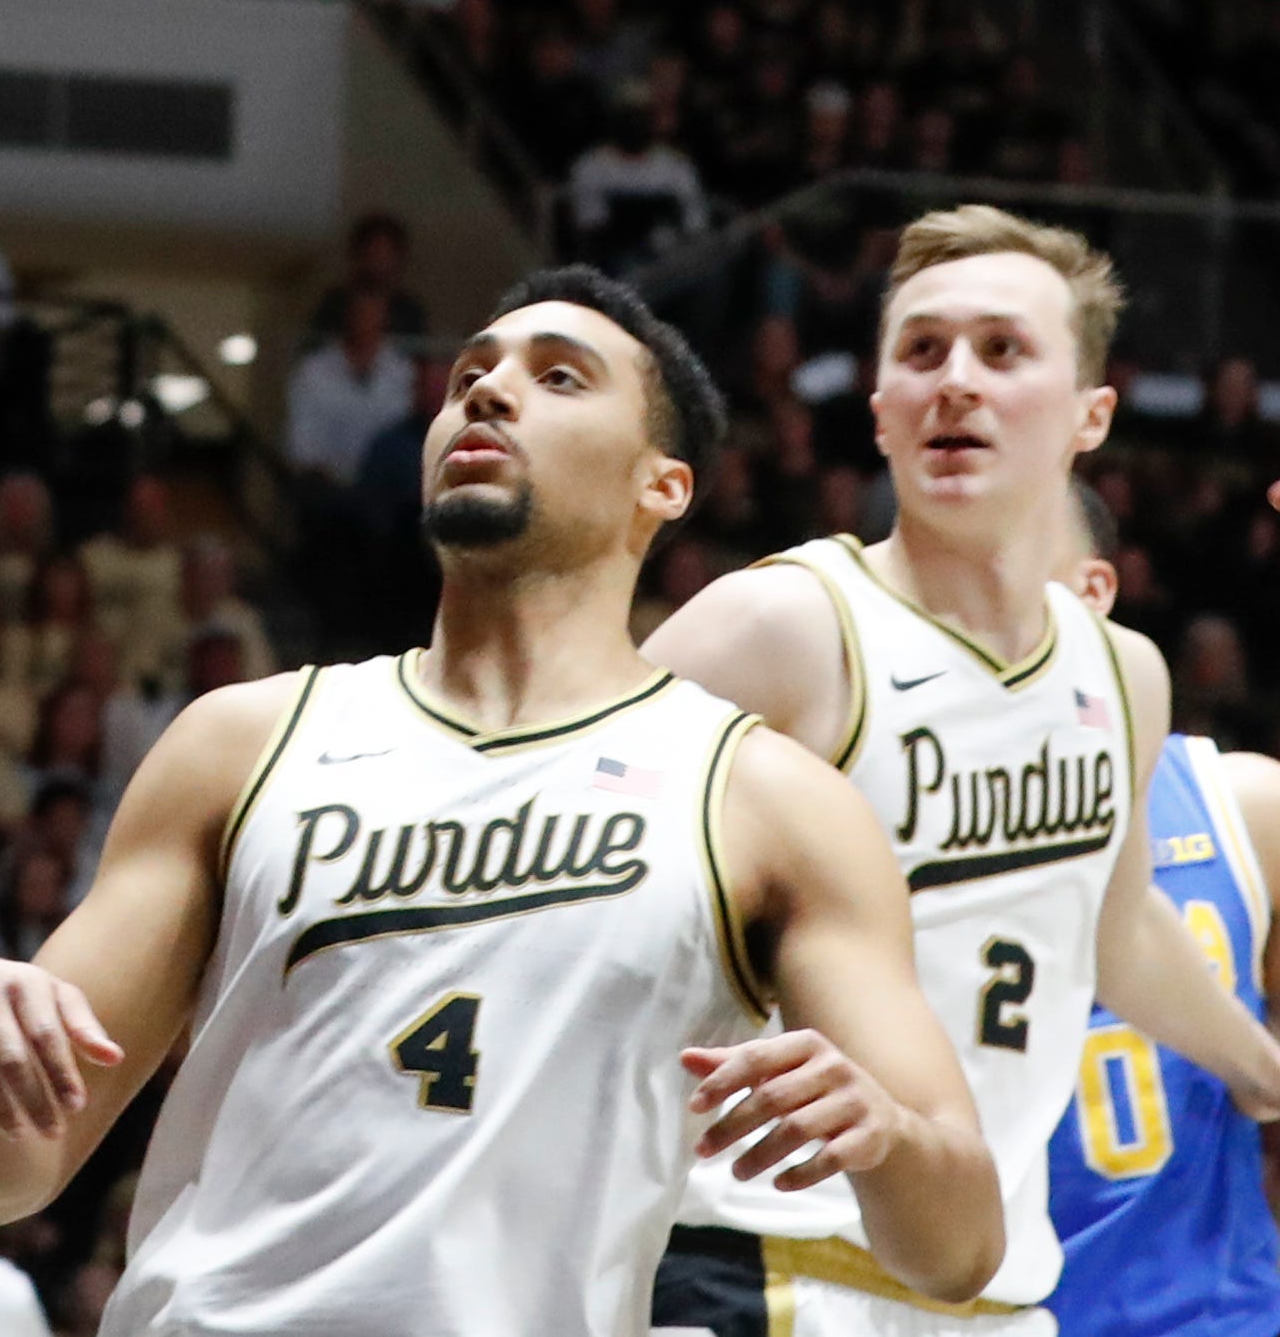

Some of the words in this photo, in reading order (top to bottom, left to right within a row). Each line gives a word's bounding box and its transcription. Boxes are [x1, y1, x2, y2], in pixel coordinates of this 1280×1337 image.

[896, 726, 1116, 851] Purdue
[277, 791, 648, 918] Purdue
[389, 991, 482, 1115] 4
[977, 935, 1036, 1054] 2
[1075, 1022, 1175, 1181] 0
